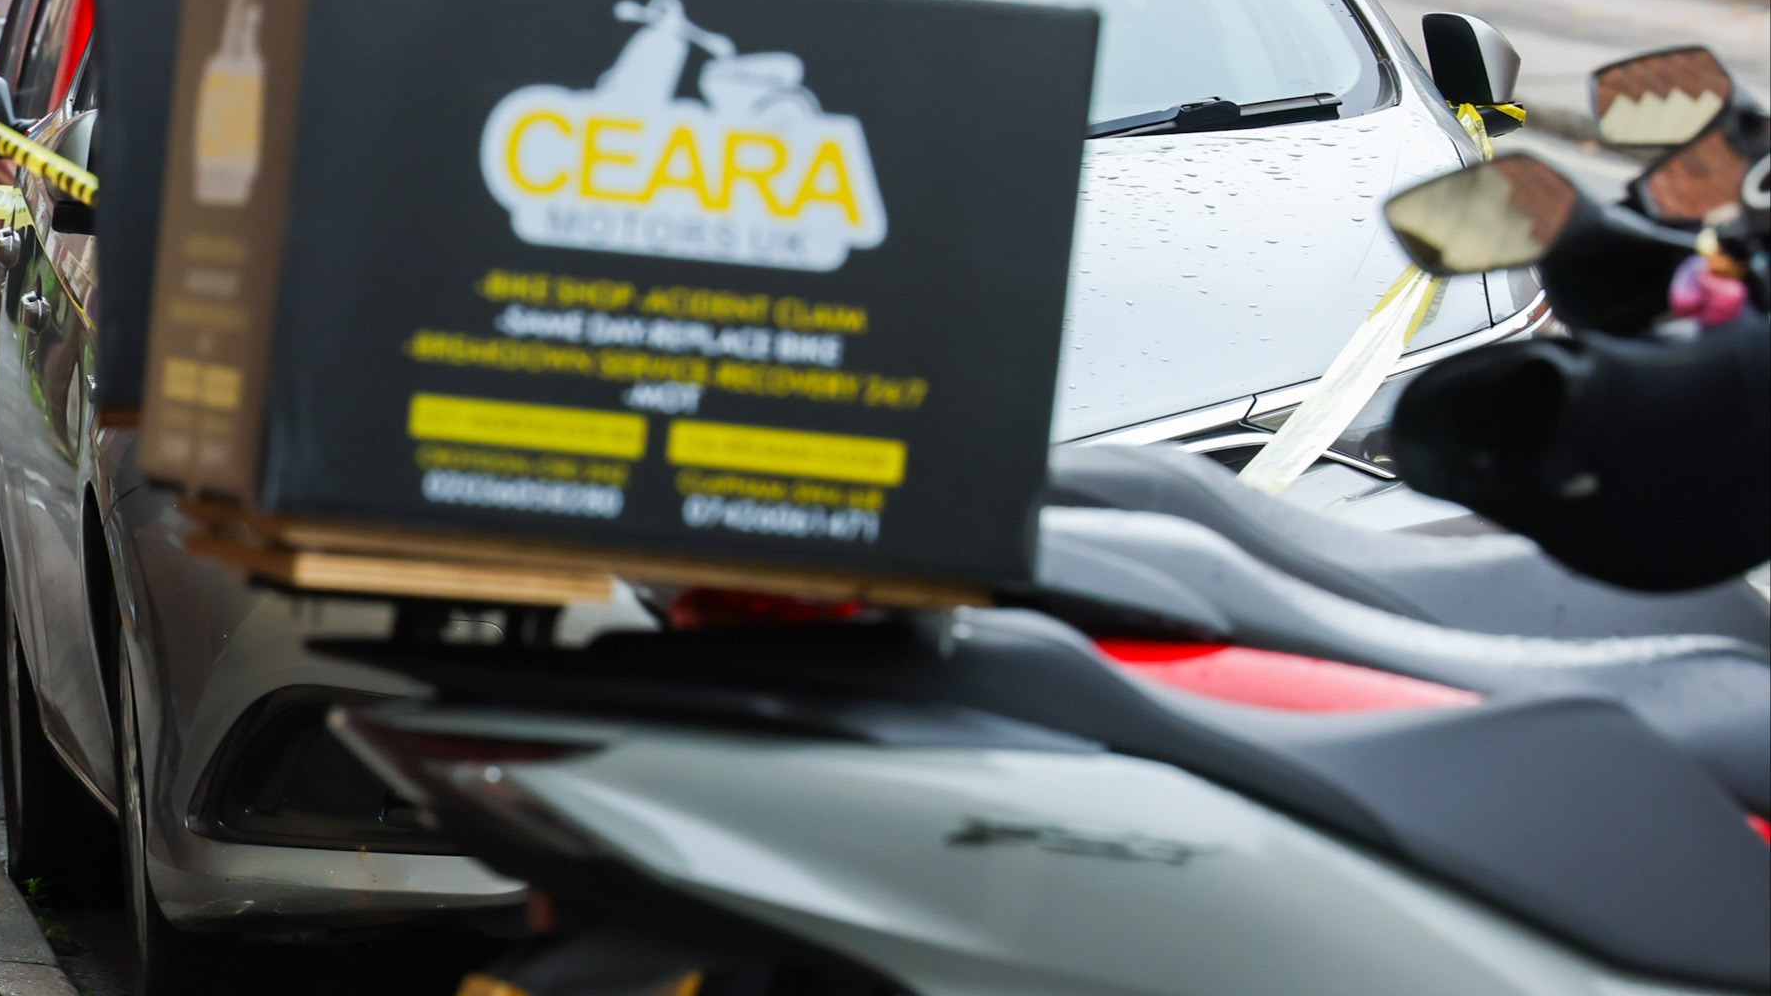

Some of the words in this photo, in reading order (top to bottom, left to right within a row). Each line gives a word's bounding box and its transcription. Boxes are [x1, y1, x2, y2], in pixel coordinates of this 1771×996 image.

[504, 109, 863, 227] CEARA
[545, 207, 740, 253] MOTORS
[746, 222, 811, 257] UK
